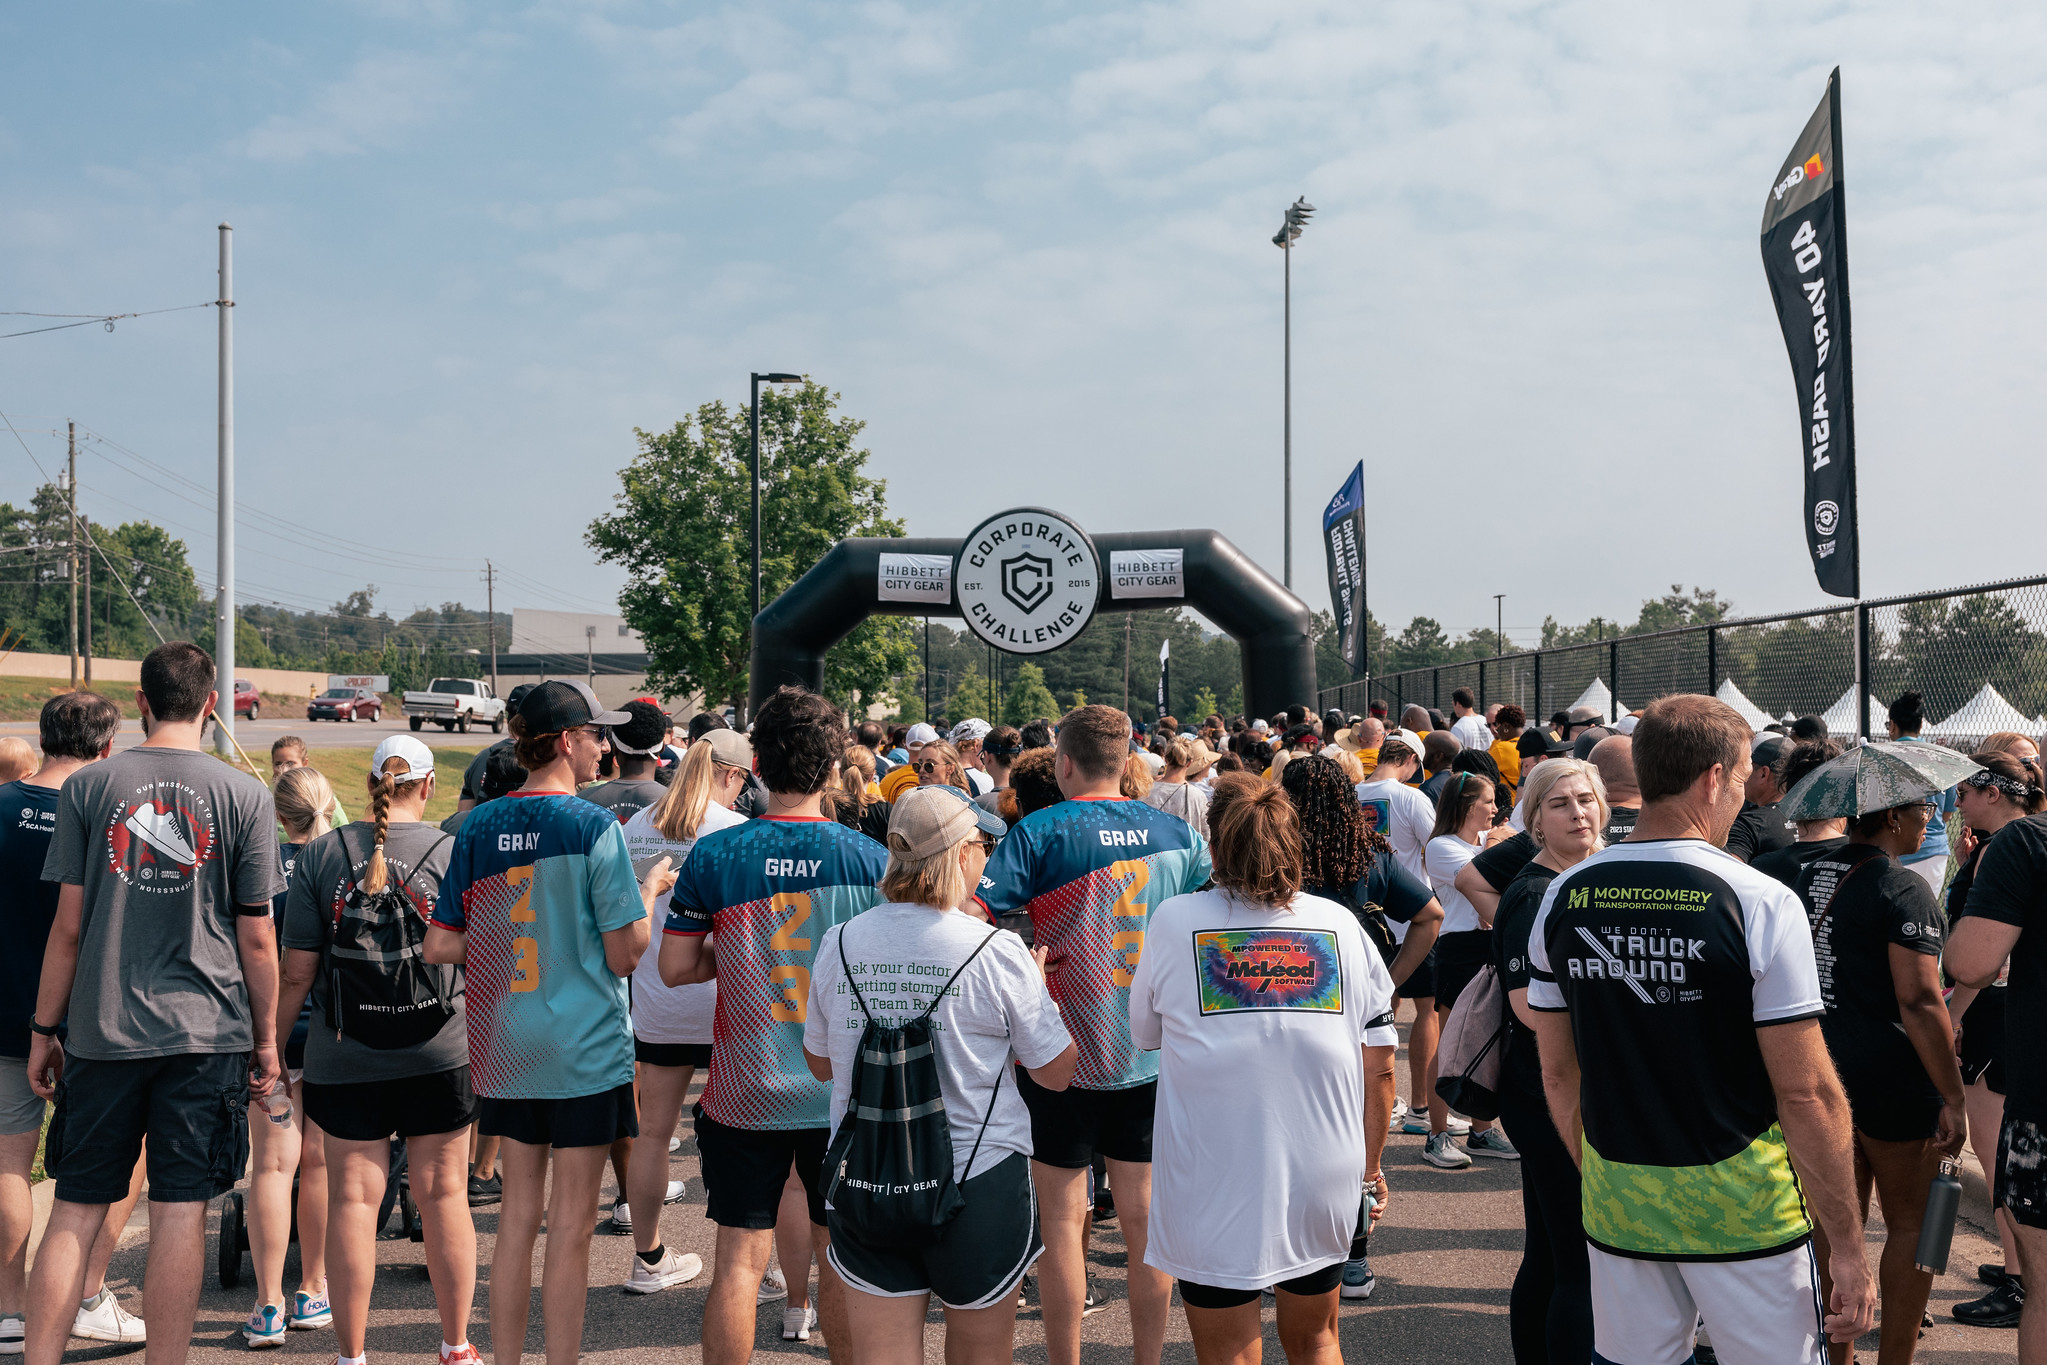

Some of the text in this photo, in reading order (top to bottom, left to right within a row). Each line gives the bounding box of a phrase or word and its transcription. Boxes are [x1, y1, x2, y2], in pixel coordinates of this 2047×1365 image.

[969, 522, 1084, 568] CORPORATE
[886, 566, 944, 577] HIBBETT
[1118, 562, 1176, 572] HIBBETT
[885, 580, 944, 591] CITY GEAR
[1068, 580, 1091, 588] 2015
[1118, 576, 1177, 587] CITY GEAR
[971, 601, 1084, 644] CHALLENGE
[136, 783, 154, 794] OUR
[159, 781, 195, 795] MISSION
[196, 796, 205, 805] IS
[204, 807, 212, 819] TO
[202, 823, 215, 860] INSPIRE
[498, 832, 540, 851] GRAY
[629, 836, 643, 844] Ask
[1099, 829, 1148, 846] GRAY
[352, 860, 369, 871] OUR
[383, 857, 408, 870] SSION
[418, 878, 427, 889] TO
[765, 858, 822, 877] GRAY
[115, 866, 134, 886] FROM
[1594, 887, 1712, 904] MONTGOMERY
[1594, 902, 1705, 912] TRANSPORTATION GROUP
[1601, 926, 1672, 936] WE DON'T
[1231, 944, 1307, 953] MPOWERED BY
[1607, 935, 1706, 962] TRUCK
[871, 963, 904, 976] your
[907, 962, 952, 978] doctor
[1225, 959, 1316, 980] McLeod
[1568, 958, 1686, 984] AROUND
[837, 979, 961, 997] if getting stomped
[359, 1004, 391, 1012] HIBBETT
[417, 998, 438, 1009] GEAR
[869, 998, 908, 1010] Team
[846, 1017, 858, 1029] is
[862, 1016, 894, 1027] rght
[1382, 1012, 1394, 1022] EAR
[846, 1178, 938, 1194] HIBBETT CTY GEAR
[308, 1300, 328, 1310] HOKA
